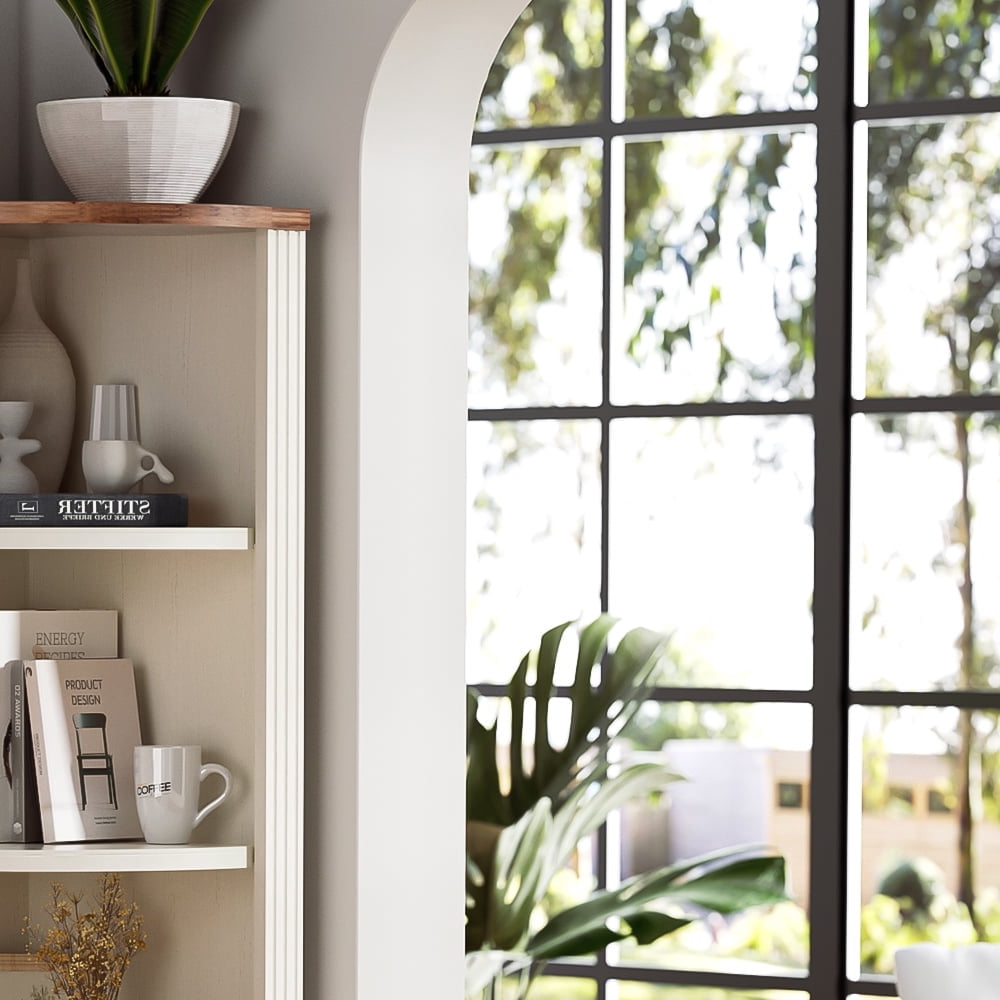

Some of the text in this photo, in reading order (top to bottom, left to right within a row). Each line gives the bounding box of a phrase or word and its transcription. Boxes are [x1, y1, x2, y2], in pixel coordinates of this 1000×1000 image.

[35, 632, 86, 646] ENERGY
[65, 679, 103, 691] PRODUCT
[71, 695, 101, 706] DESIGN
[137, 781, 172, 796] COFFEE
